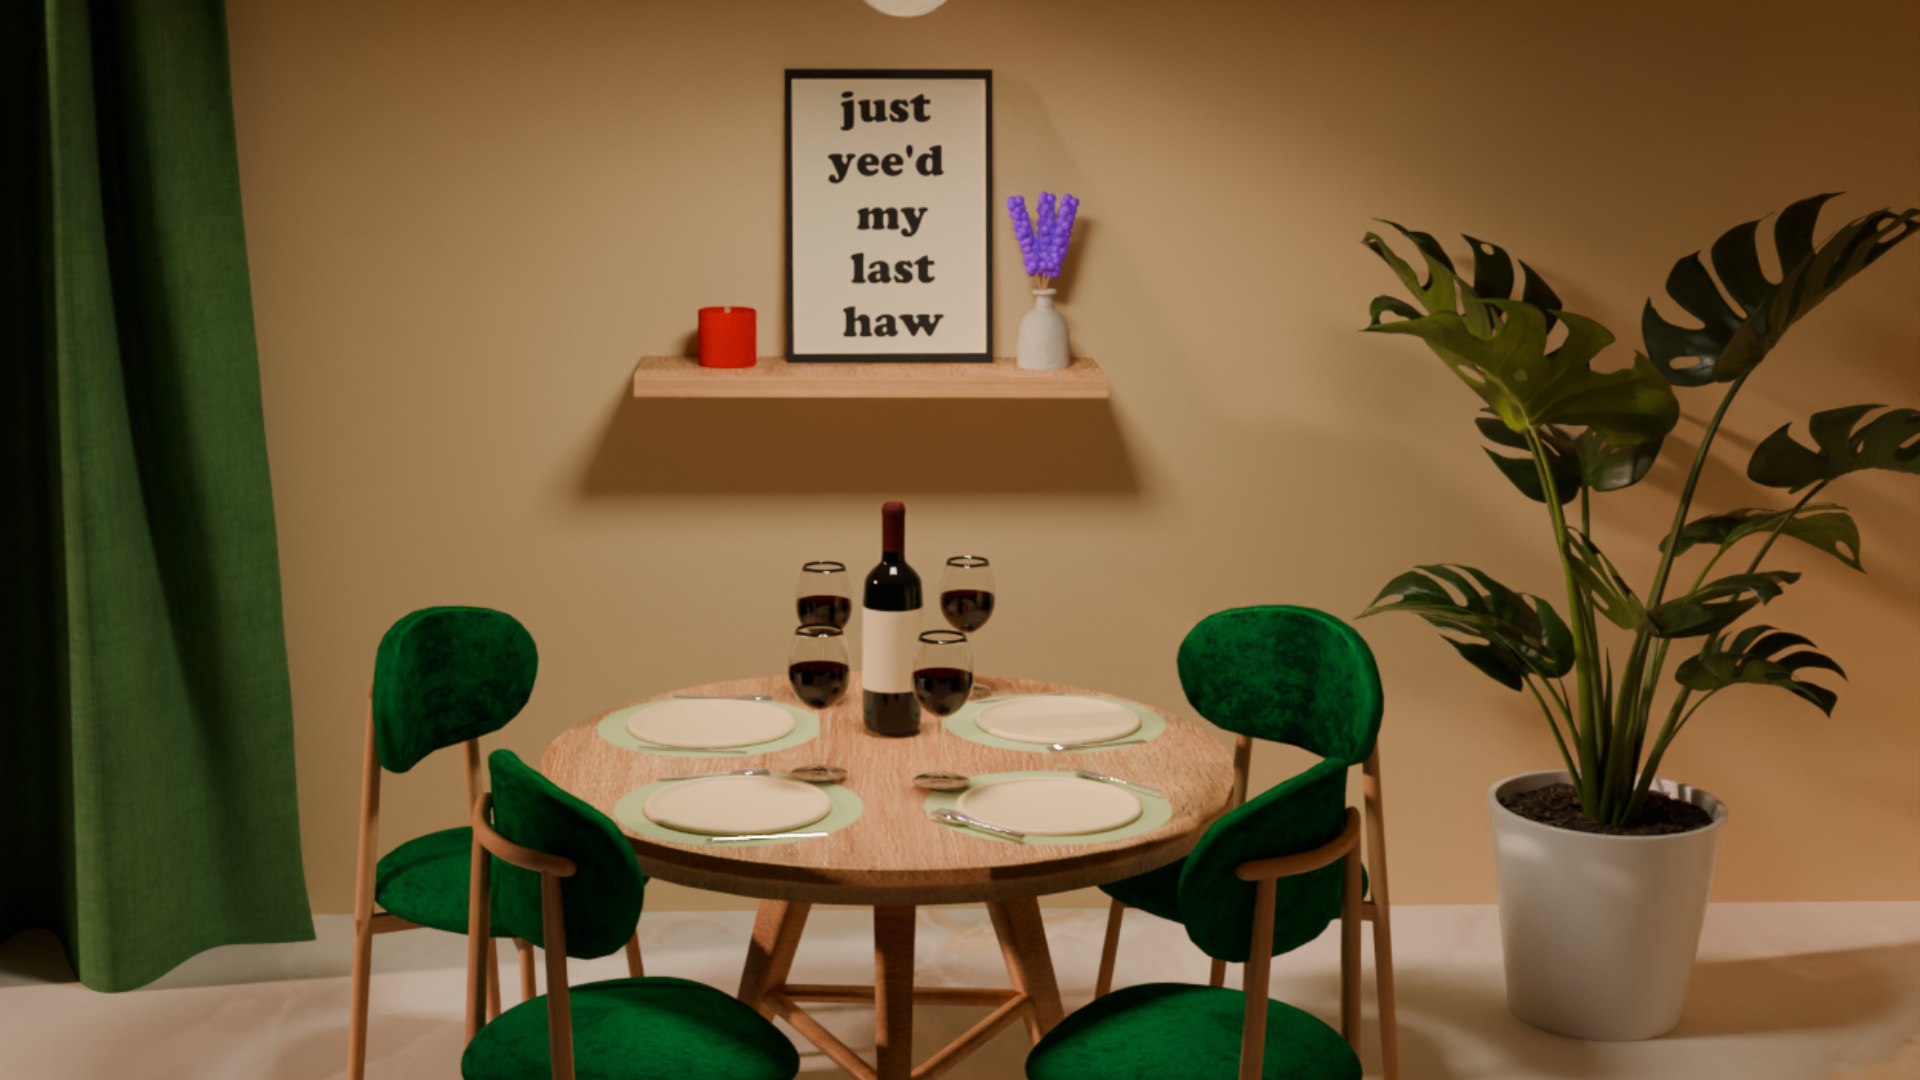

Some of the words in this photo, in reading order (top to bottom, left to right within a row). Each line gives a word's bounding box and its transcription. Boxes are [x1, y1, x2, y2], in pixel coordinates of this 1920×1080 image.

[840, 90, 931, 131] just
[827, 144, 945, 184] yee'd
[856, 206, 929, 237] my
[850, 252, 935, 284] last
[842, 306, 944, 337] haw
